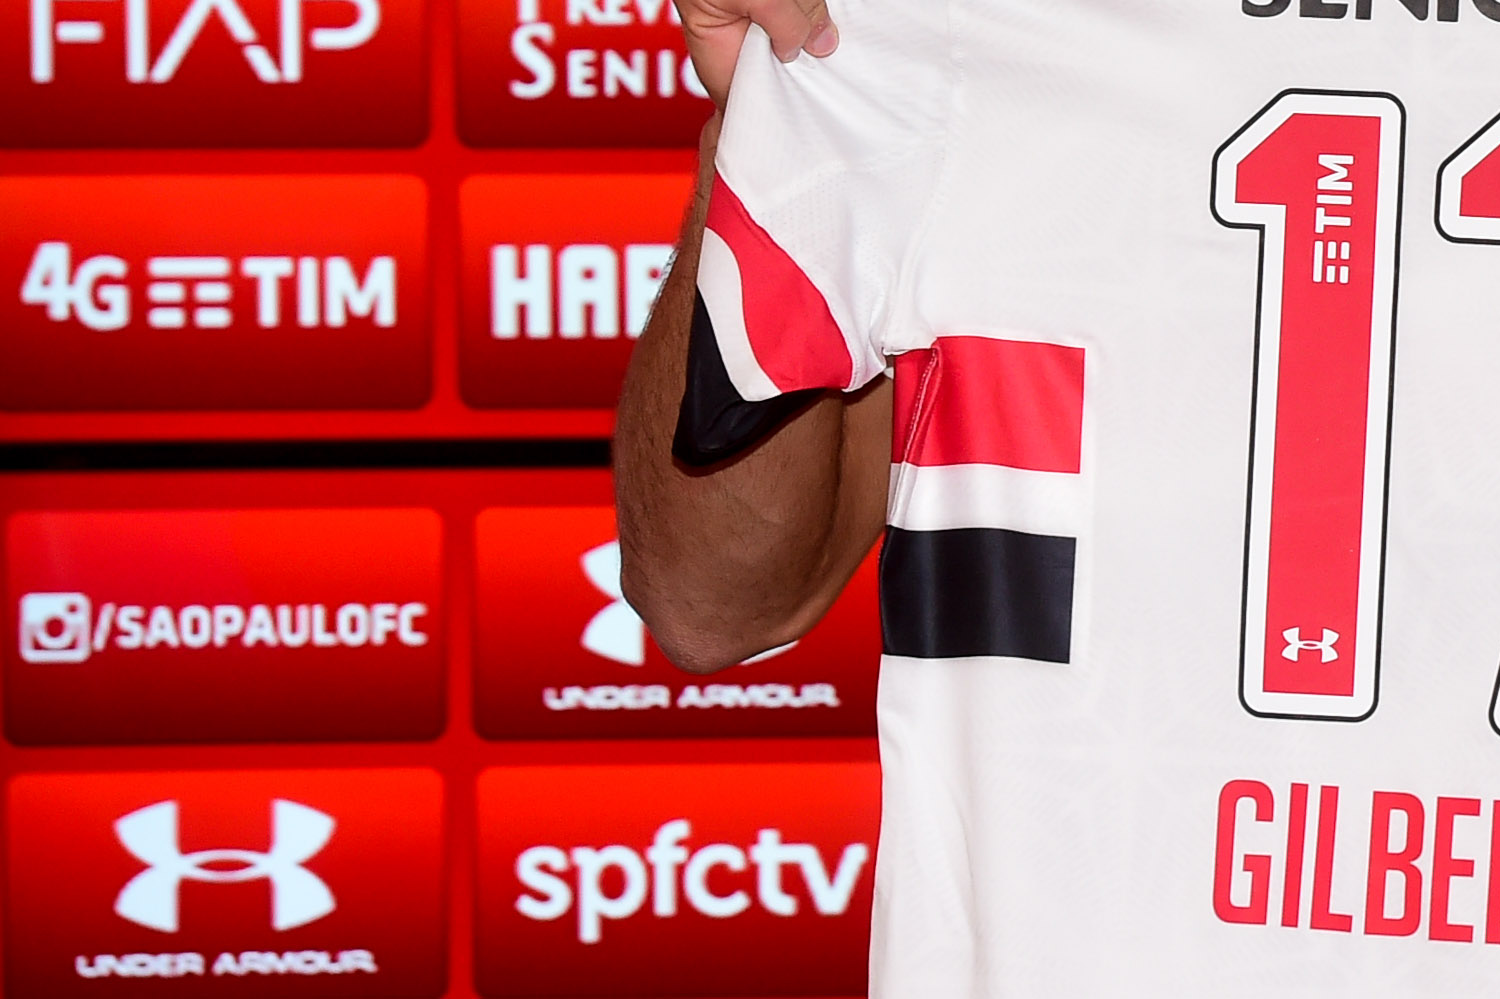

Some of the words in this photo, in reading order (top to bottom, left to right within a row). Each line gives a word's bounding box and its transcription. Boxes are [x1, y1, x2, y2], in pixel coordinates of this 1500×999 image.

[1314, 152, 1356, 234] TIM
[21, 242, 129, 330] 4G
[242, 256, 395, 327] TIM
[92, 603, 426, 650] /SAOPAULOFC
[545, 685, 670, 710] UNDER
[678, 684, 839, 708] ARMOUR
[514, 818, 868, 944] spfctv
[77, 953, 204, 977] UNDER
[214, 950, 376, 974] ARMOUR
